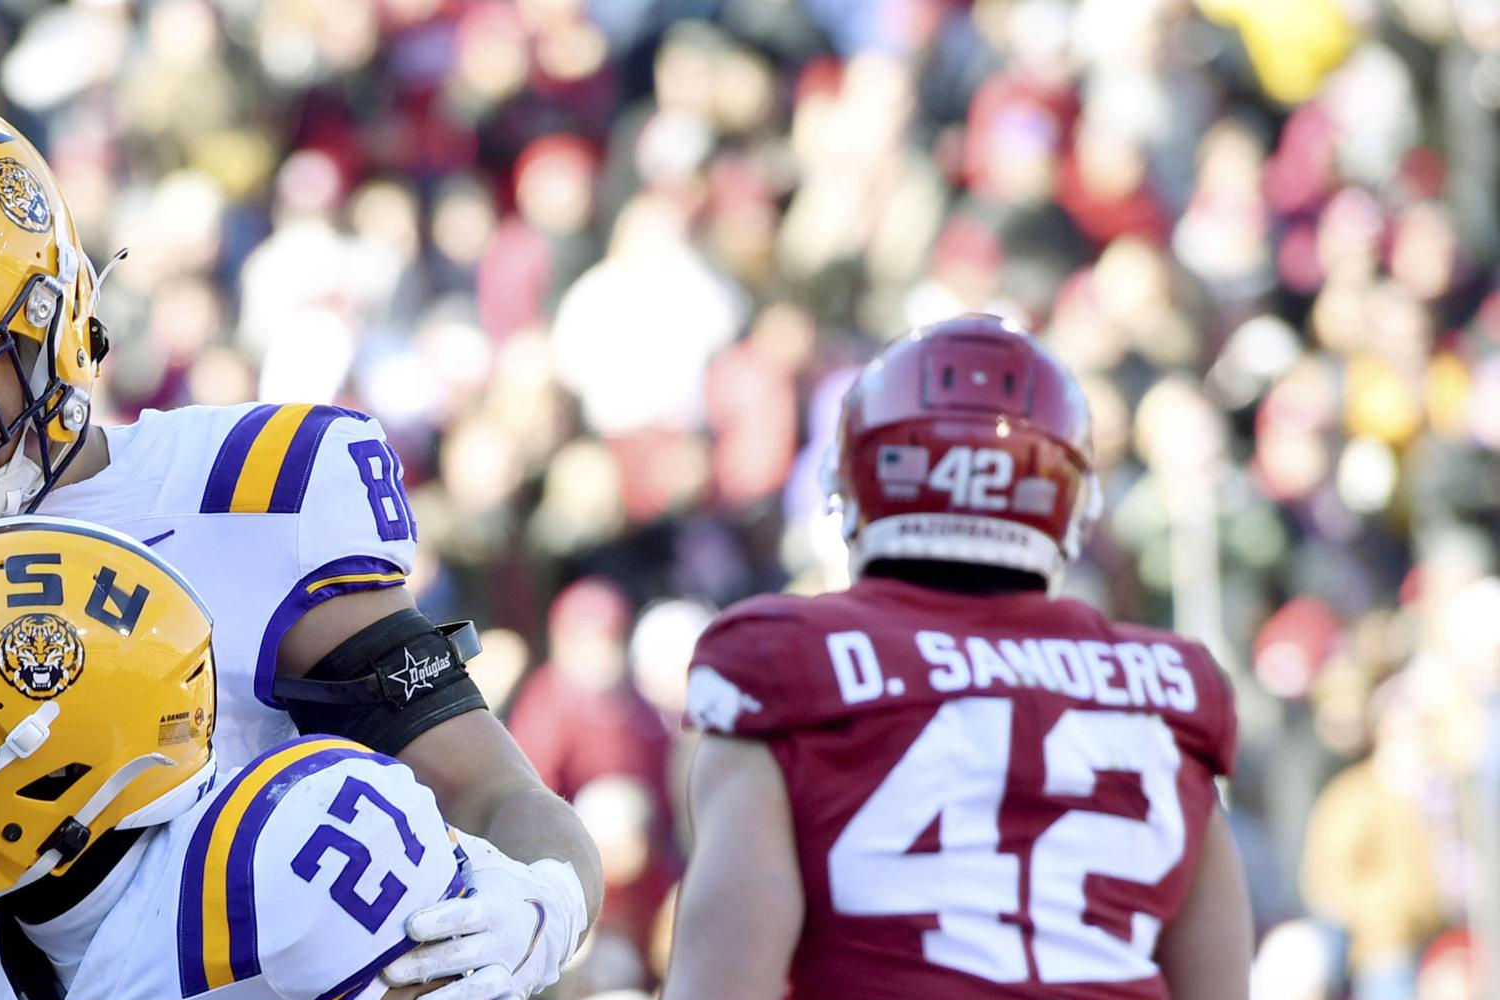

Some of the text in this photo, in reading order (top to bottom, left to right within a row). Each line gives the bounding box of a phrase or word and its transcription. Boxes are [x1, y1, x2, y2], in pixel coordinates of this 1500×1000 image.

[348, 439, 418, 542] 8
[929, 447, 1013, 511] 42
[408, 655, 451, 684] Douglas
[826, 630, 1197, 713] D. SANDERS
[166, 711, 190, 722] DANGER
[290, 775, 426, 935] 27
[827, 697, 1186, 984] 42
